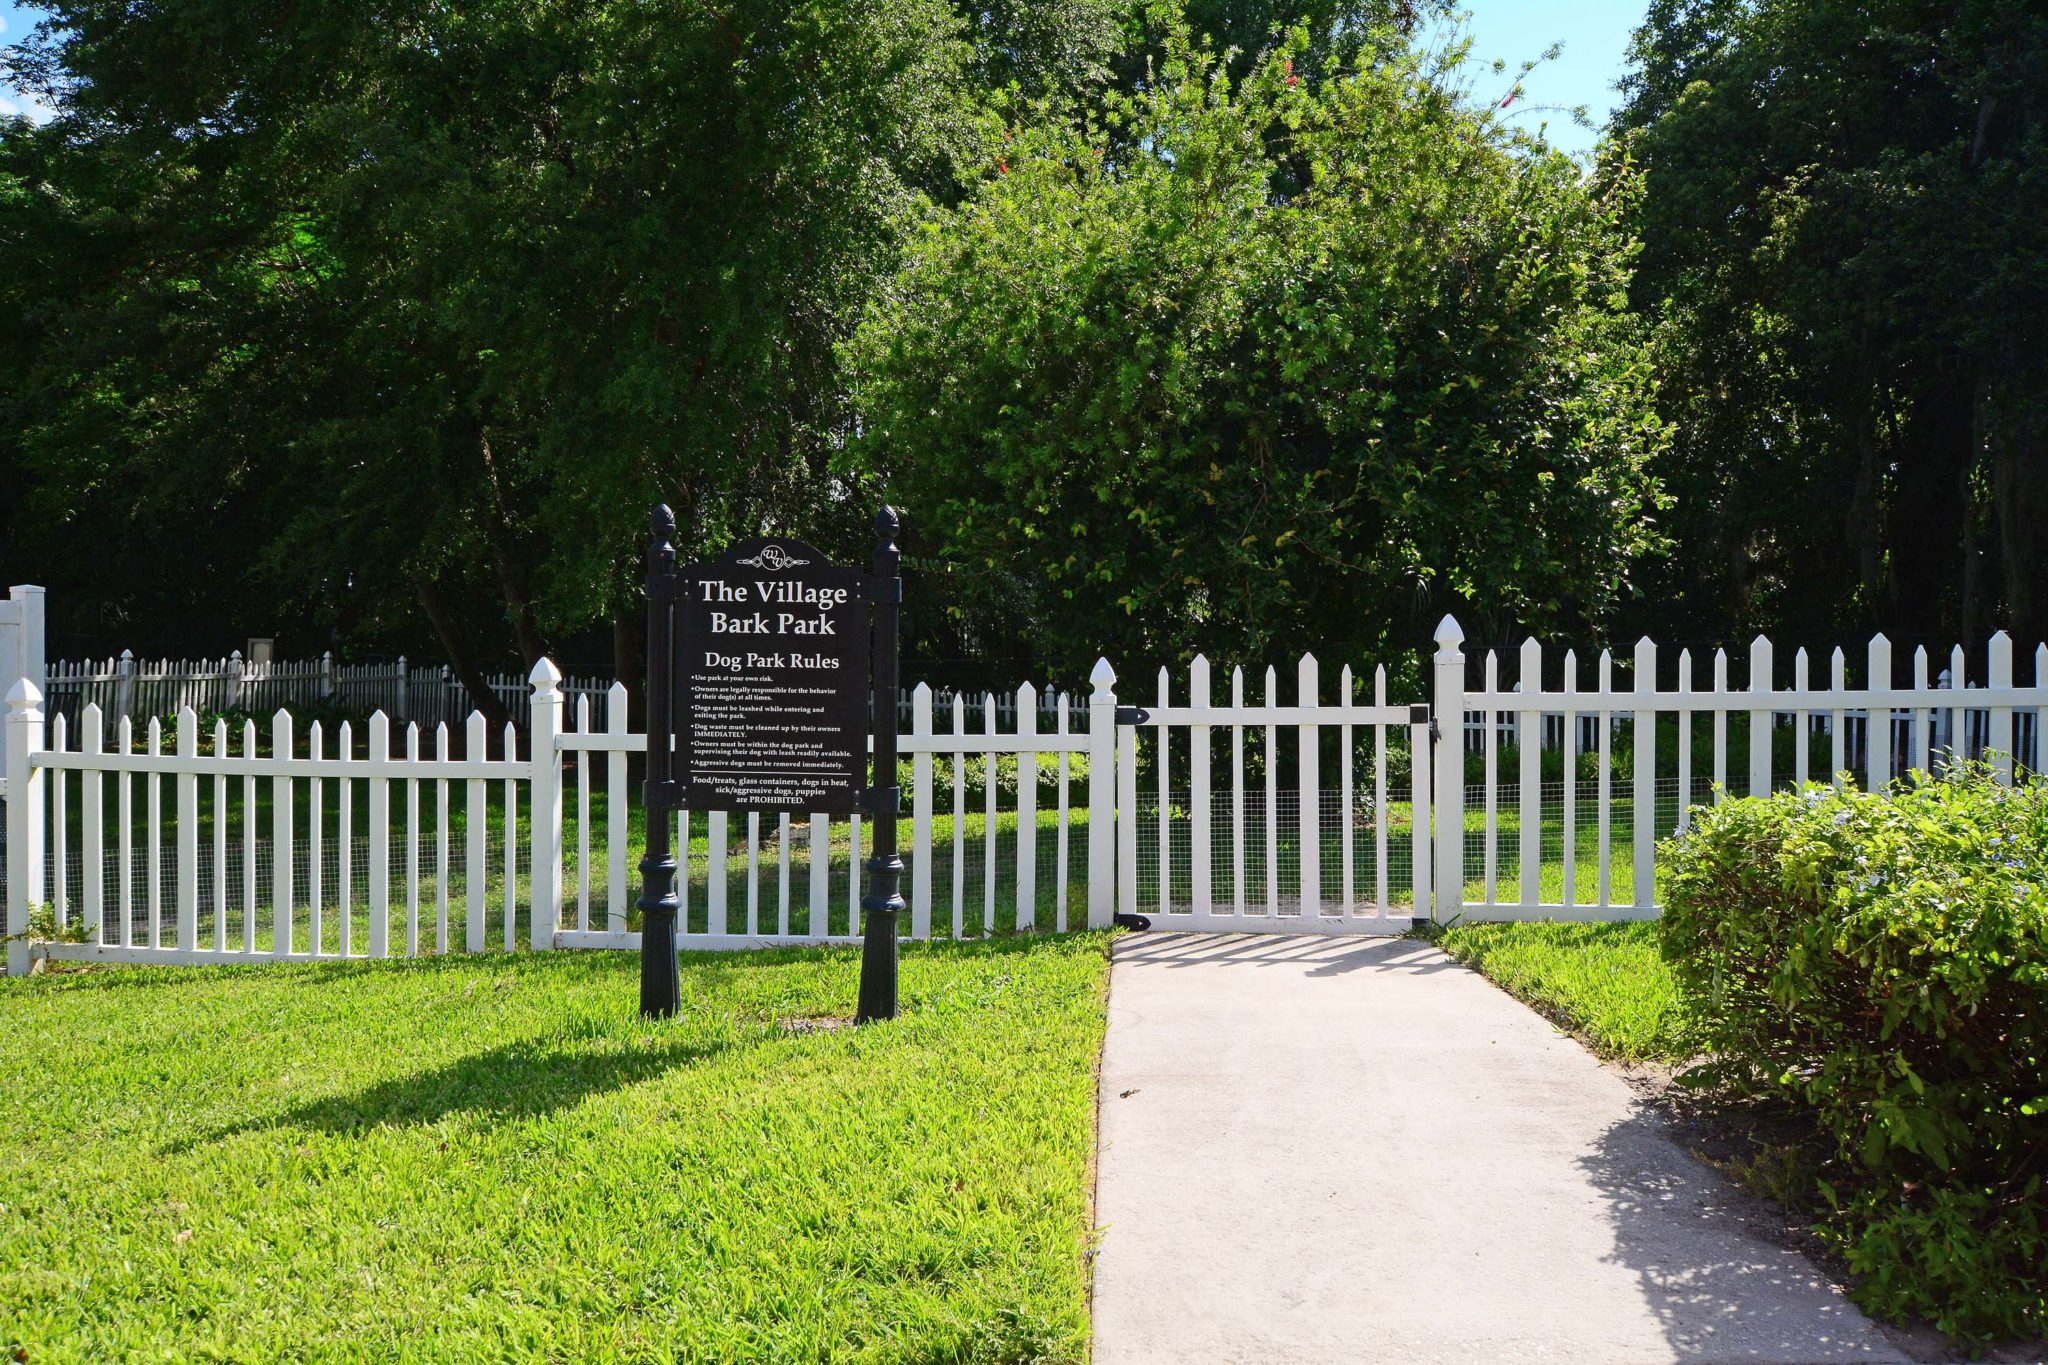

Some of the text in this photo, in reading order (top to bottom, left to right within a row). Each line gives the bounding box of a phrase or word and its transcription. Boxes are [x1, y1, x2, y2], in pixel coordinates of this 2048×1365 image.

[699, 580, 847, 610] The Village
[710, 612, 836, 635] Bark Park
[705, 652, 839, 671] Dog Park Rules
[730, 686, 750, 694] legally
[752, 687, 787, 695] responsible
[718, 694, 737, 702] dog(s)
[695, 705, 711, 713] Dogs
[781, 742, 793, 750] dog
[795, 742, 809, 750] park
[694, 749, 731, 757] supervising
[749, 749, 761, 757] dog
[730, 760, 745, 768] dogs
[693, 776, 737, 785] Food/treats,
[739, 777, 757, 786] glass
[759, 778, 800, 786] containers,
[801, 778, 819, 787] dogs
[830, 778, 849, 787] heat,
[715, 786, 826, 796] sick/aggressive dogs, puppies
